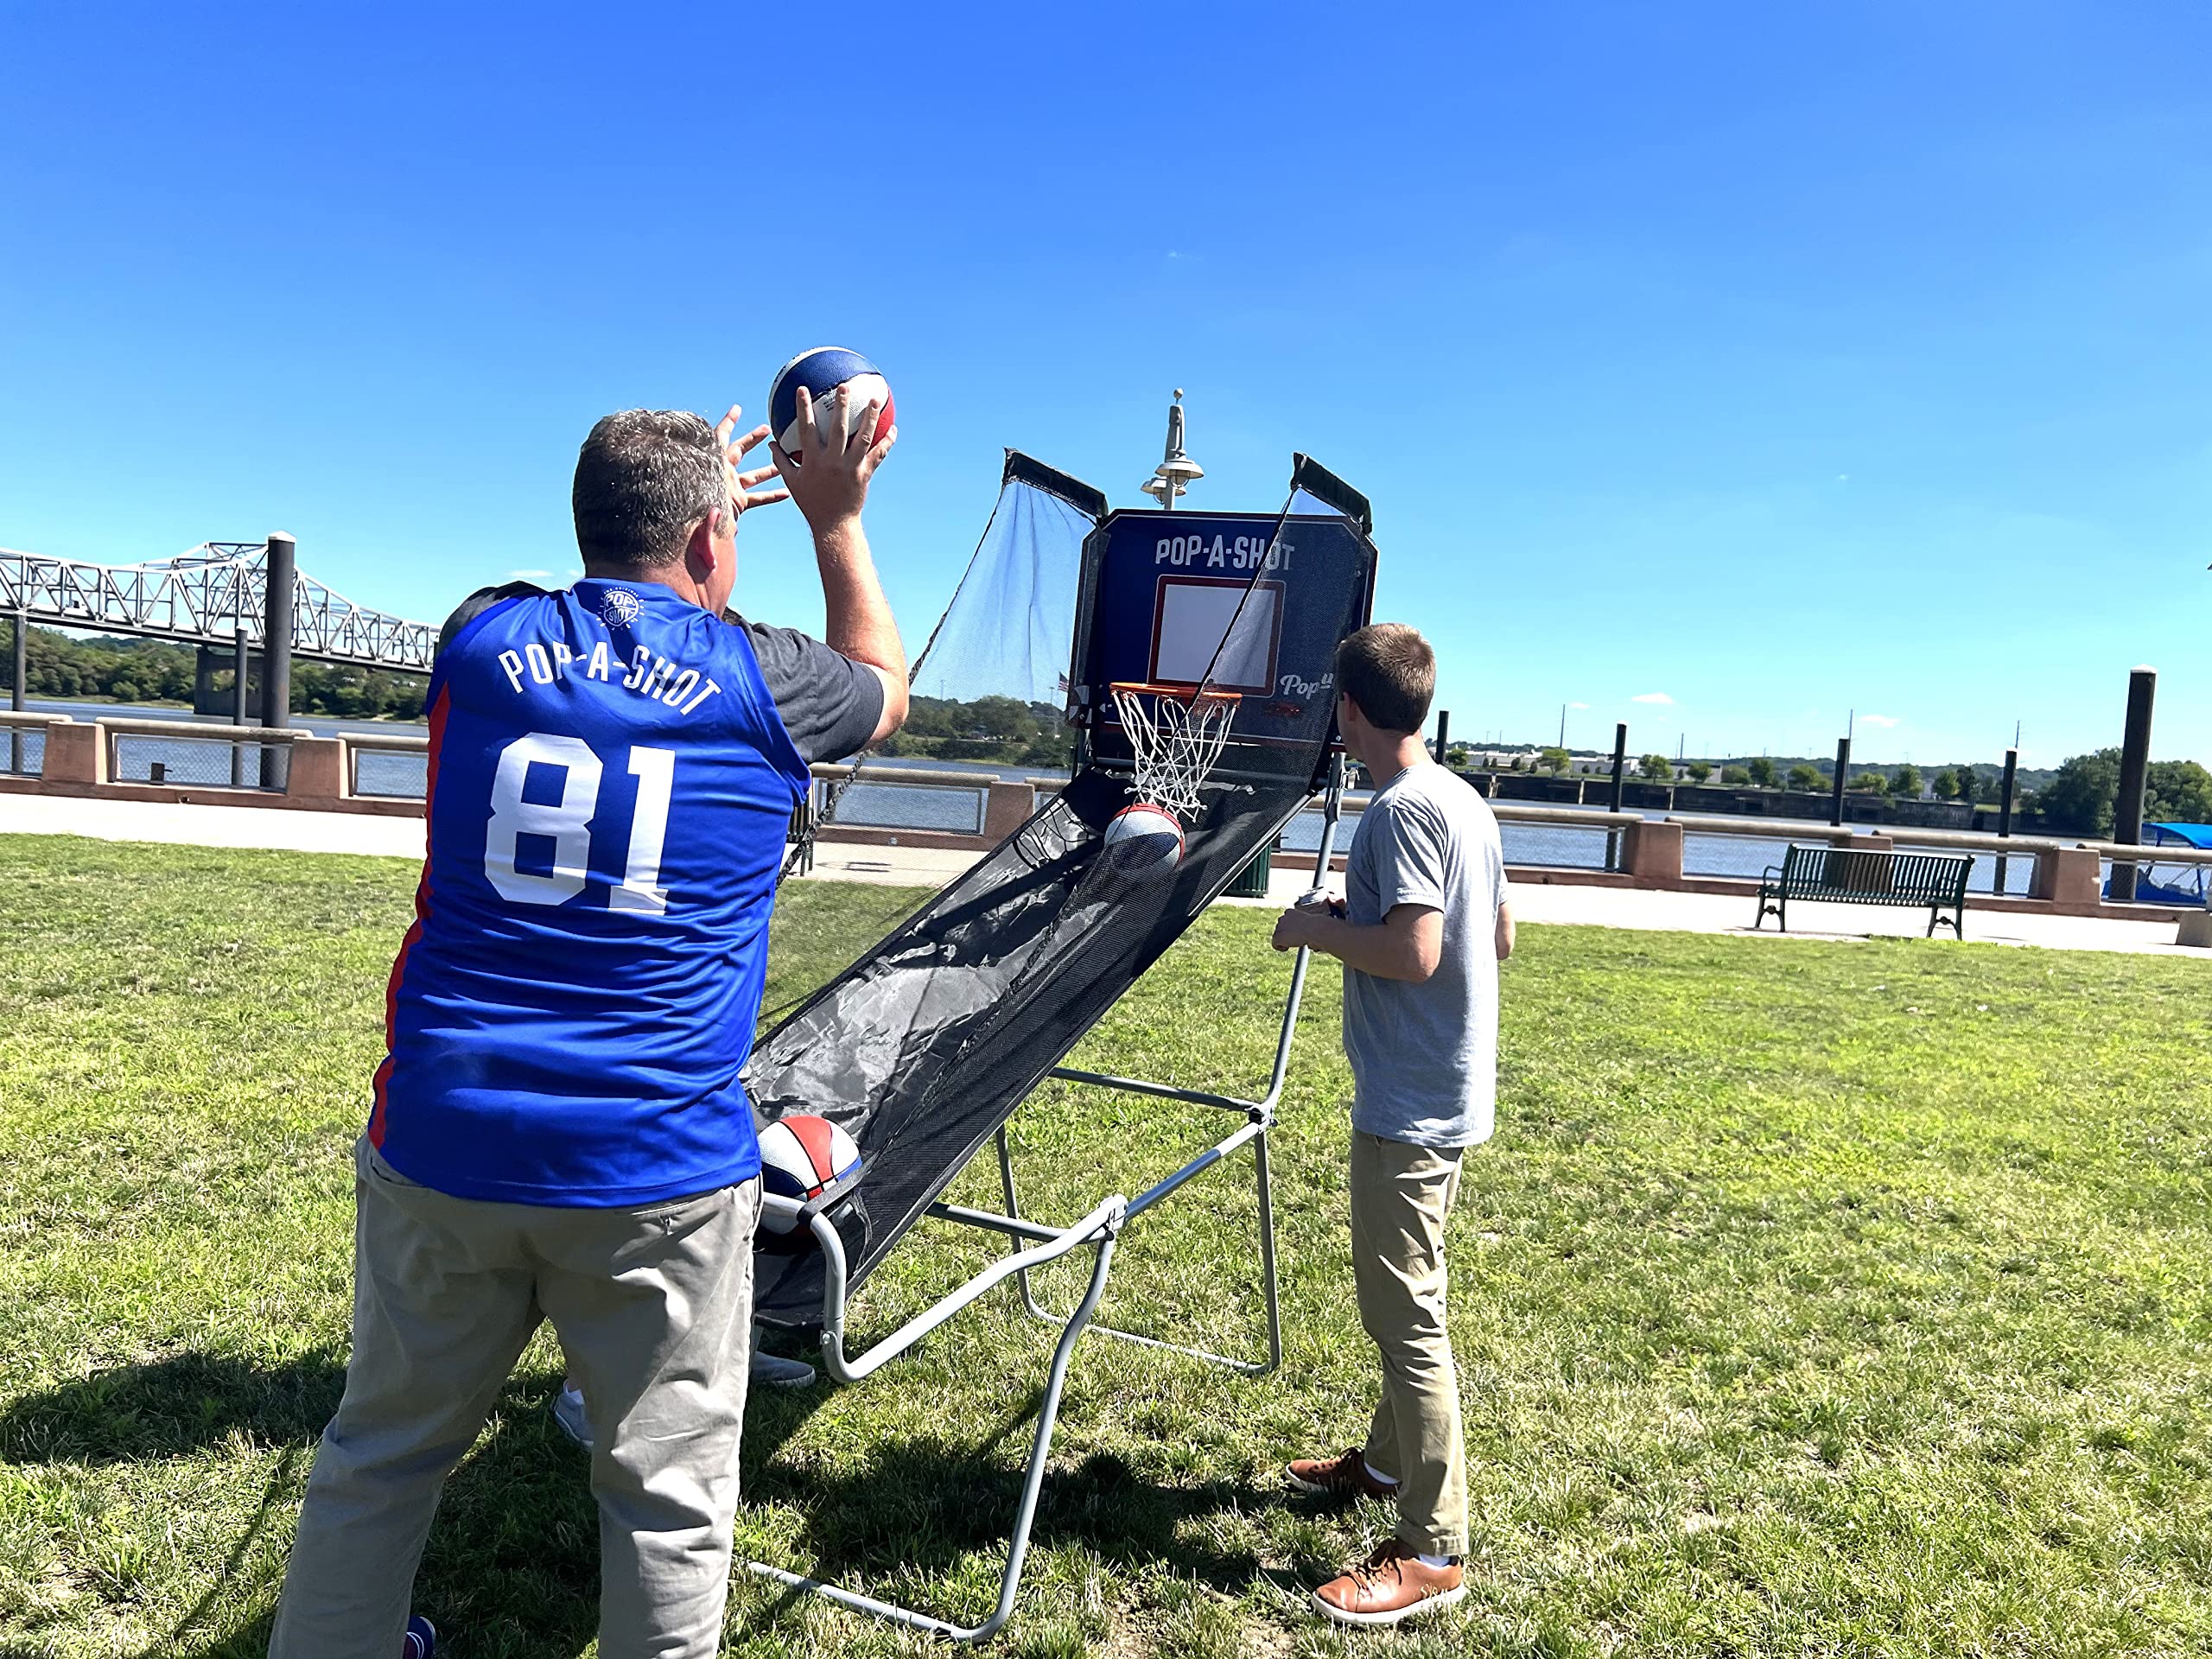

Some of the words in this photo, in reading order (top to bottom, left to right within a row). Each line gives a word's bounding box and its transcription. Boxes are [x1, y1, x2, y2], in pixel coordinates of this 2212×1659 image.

[1154, 534, 1295, 571] POP-A-SHOT
[498, 640, 722, 716] POP-A-SHOT
[484, 731, 676, 916] 81
